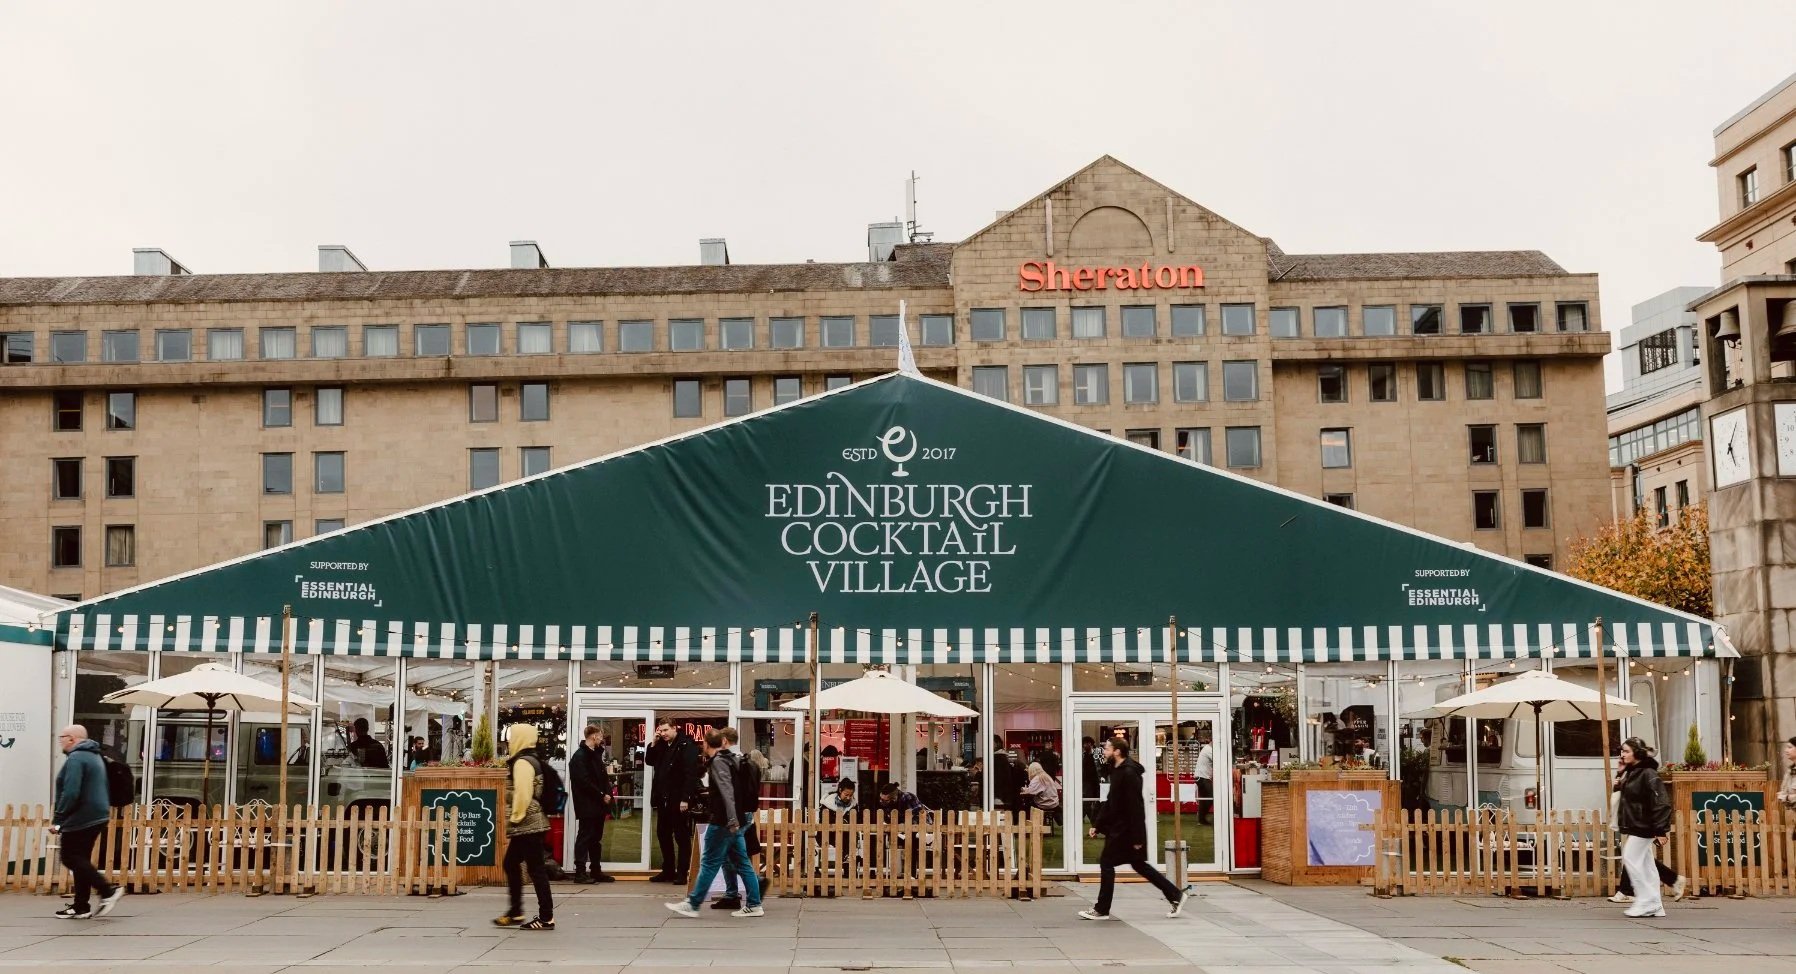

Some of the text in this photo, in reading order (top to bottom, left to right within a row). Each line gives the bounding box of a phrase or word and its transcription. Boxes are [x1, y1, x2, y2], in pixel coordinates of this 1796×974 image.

[1020, 259, 1206, 291] Sheraton
[842, 448, 956, 462] ESTD 2017
[765, 471, 1033, 531] EDINBURGH
[781, 520, 1017, 556] COCKTAIL
[310, 561, 369, 571] SUPPORTED BY
[806, 560, 992, 593] VILLAGE
[1414, 569, 1471, 577] SUPPORTED BY
[301, 581, 376, 592] ESSENTIAL
[301, 590, 376, 600] EDINBURGH
[1408, 588, 1479, 598] ESSENTIAL
[1408, 597, 1479, 606] EDINBURGH
[468, 811, 481, 819] Bars
